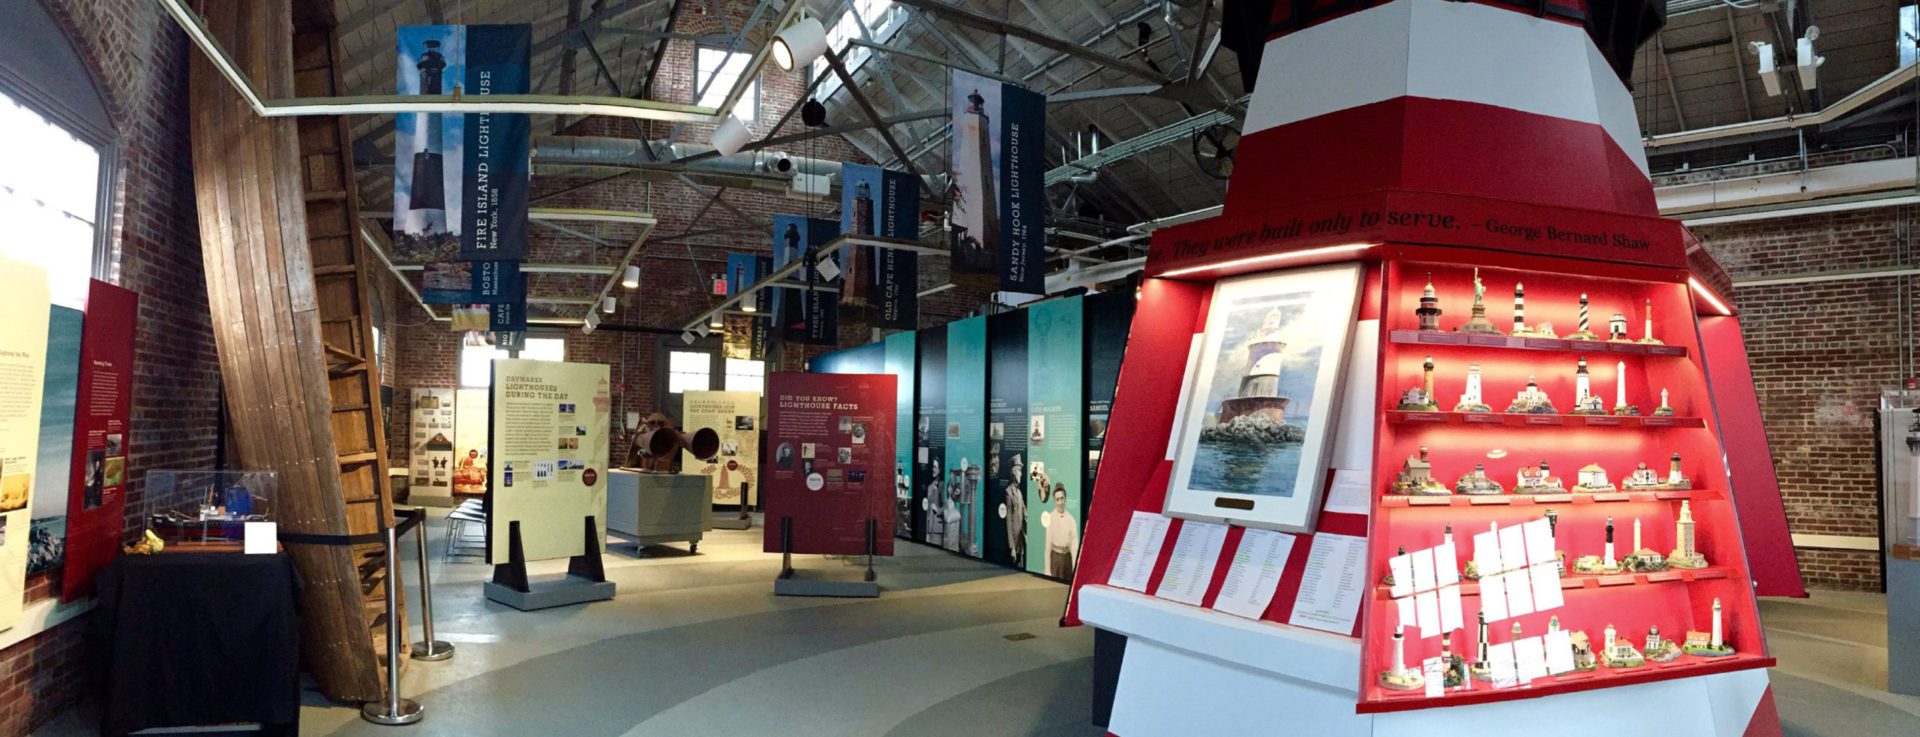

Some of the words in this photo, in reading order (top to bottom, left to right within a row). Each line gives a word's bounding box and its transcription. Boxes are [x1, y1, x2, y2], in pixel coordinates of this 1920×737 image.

[479, 70, 491, 158] LIGHTUSE
[1011, 122, 1020, 199] LIGHTHOUSE
[477, 162, 490, 214] ISLAND
[888, 178, 896, 238] LIGHTHOUSE
[1012, 202, 1021, 237] HOOK
[477, 219, 487, 249] FIRE
[490, 231, 498, 249] New
[1173, 239, 1211, 258] They
[1214, 230, 1257, 249] were
[1259, 218, 1304, 242] built
[1308, 211, 1353, 235] only
[1359, 211, 1380, 229] to
[1387, 208, 1462, 230] serve.
[1485, 218, 1541, 241] George
[1547, 226, 1608, 246] Bernard
[1612, 233, 1651, 250] Shaw
[887, 246, 895, 271] HEN
[1010, 240, 1020, 281] SANDY
[482, 262, 491, 296] BOSTO
[886, 273, 894, 298] CAPE
[505, 383, 558, 392] LIGHTHOUSES
[505, 391, 536, 399] DURING
[779, 401, 831, 409] LIGHTHOUSE
